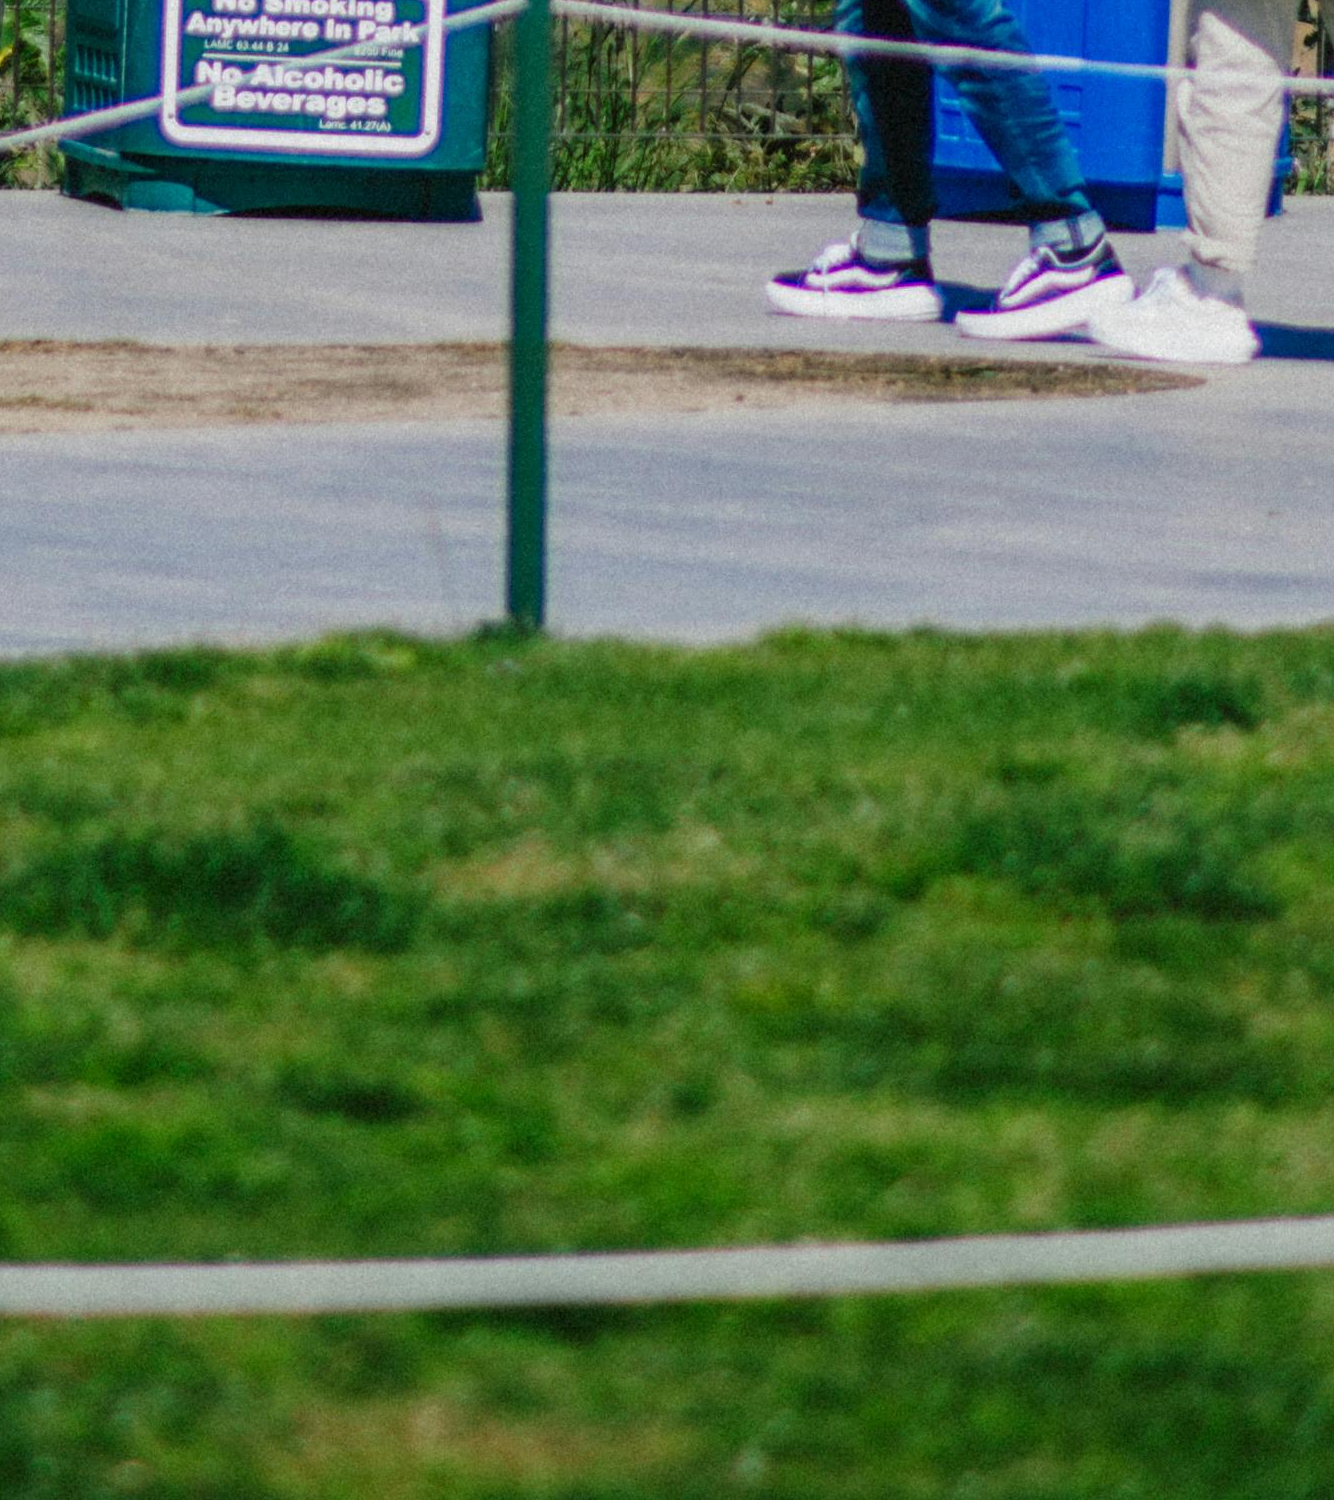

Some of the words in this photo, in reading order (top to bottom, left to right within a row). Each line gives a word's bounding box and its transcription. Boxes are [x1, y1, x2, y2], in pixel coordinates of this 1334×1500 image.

[186, 11, 320, 40] Anywhere
[324, 18, 352, 40] In
[357, 20, 419, 45] Park
[204, 39, 233, 50] LAMC
[197, 61, 242, 85] No
[249, 64, 405, 94] Alcoholic
[213, 84, 387, 119] Beverages
